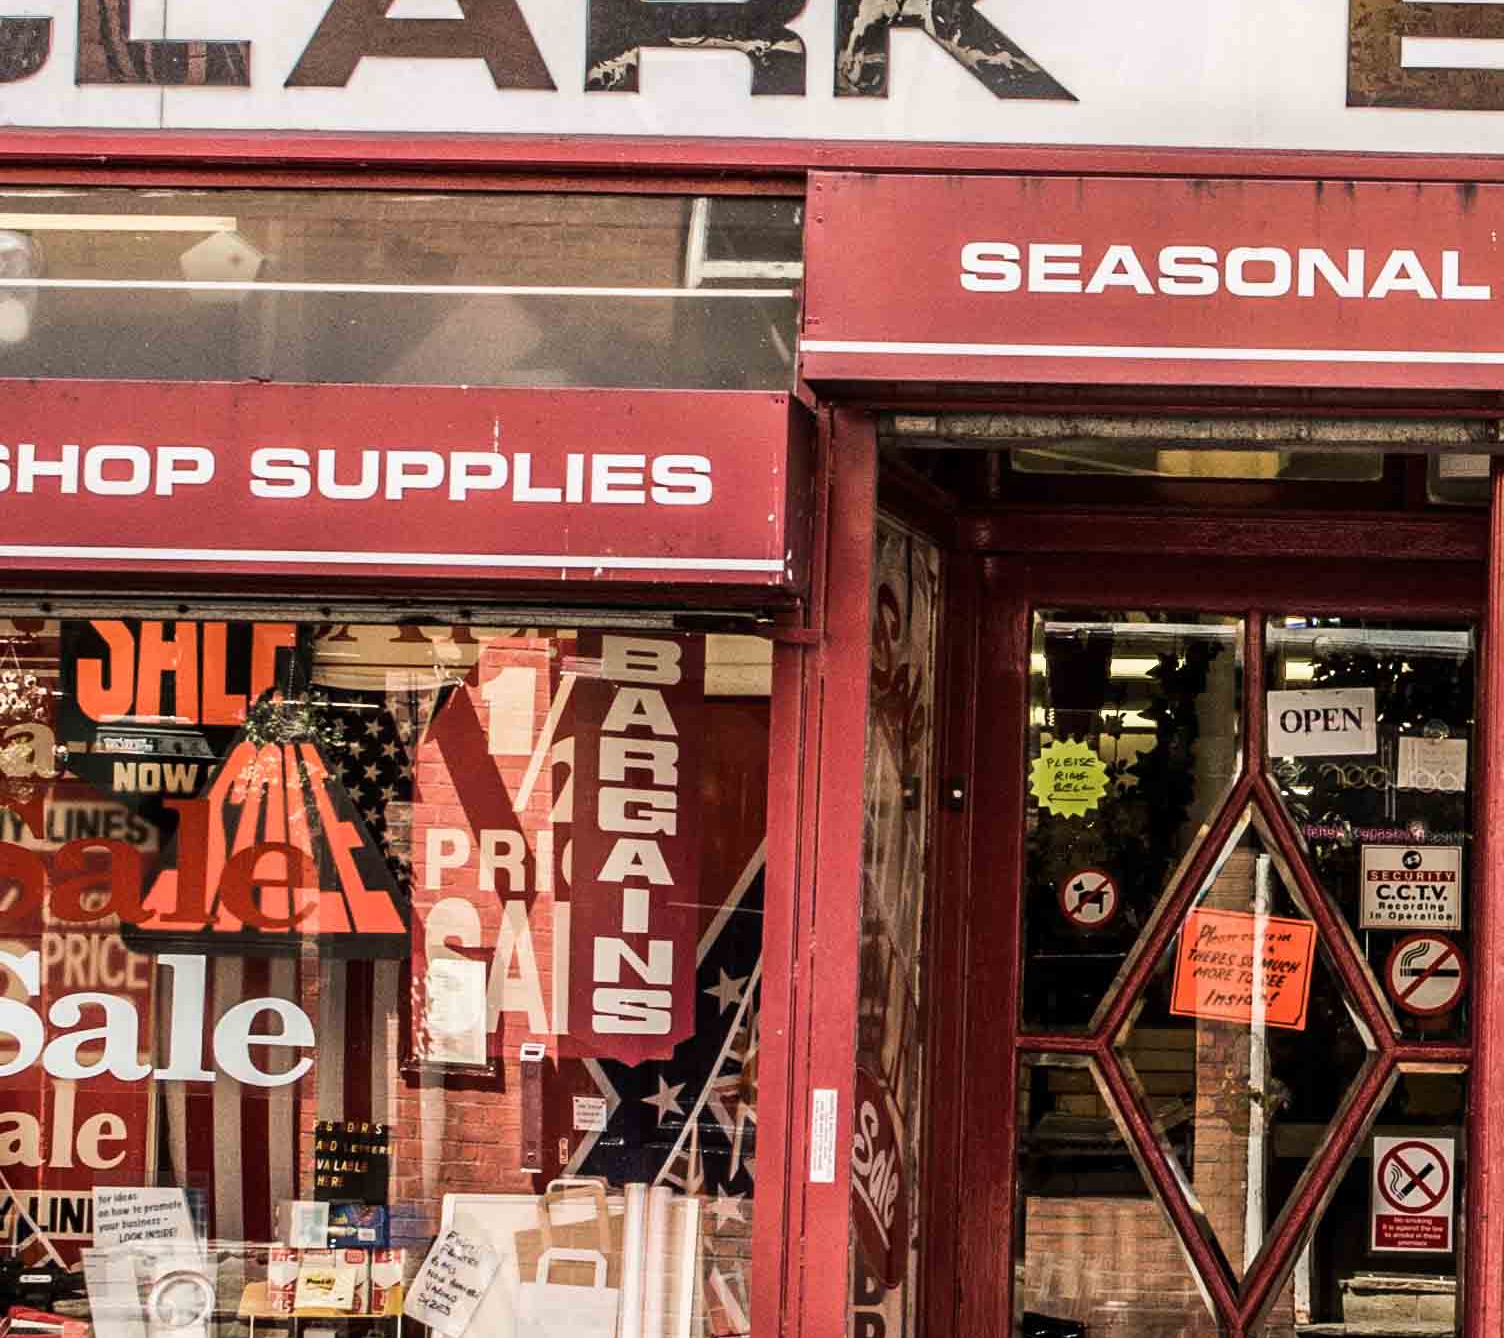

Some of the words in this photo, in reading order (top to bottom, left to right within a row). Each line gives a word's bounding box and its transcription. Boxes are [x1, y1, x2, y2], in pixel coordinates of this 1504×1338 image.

[958, 241, 1493, 301] SEASONAL
[248, 446, 714, 506] SUPPLIES
[1279, 706, 1364, 735] OPEN
[112, 761, 197, 795] NOW
[1054, 771, 1089, 781] RING
[590, 634, 683, 1037] BARGAINS
[424, 827, 572, 894] PRI
[1368, 871, 1453, 881] SECURITY
[1375, 884, 1448, 901] C.C.T.V.
[1378, 901, 1446, 912] Recording
[1388, 911, 1453, 922] Operation
[41, 931, 150, 989] PRICE
[24, 1195, 94, 1235] LIN
